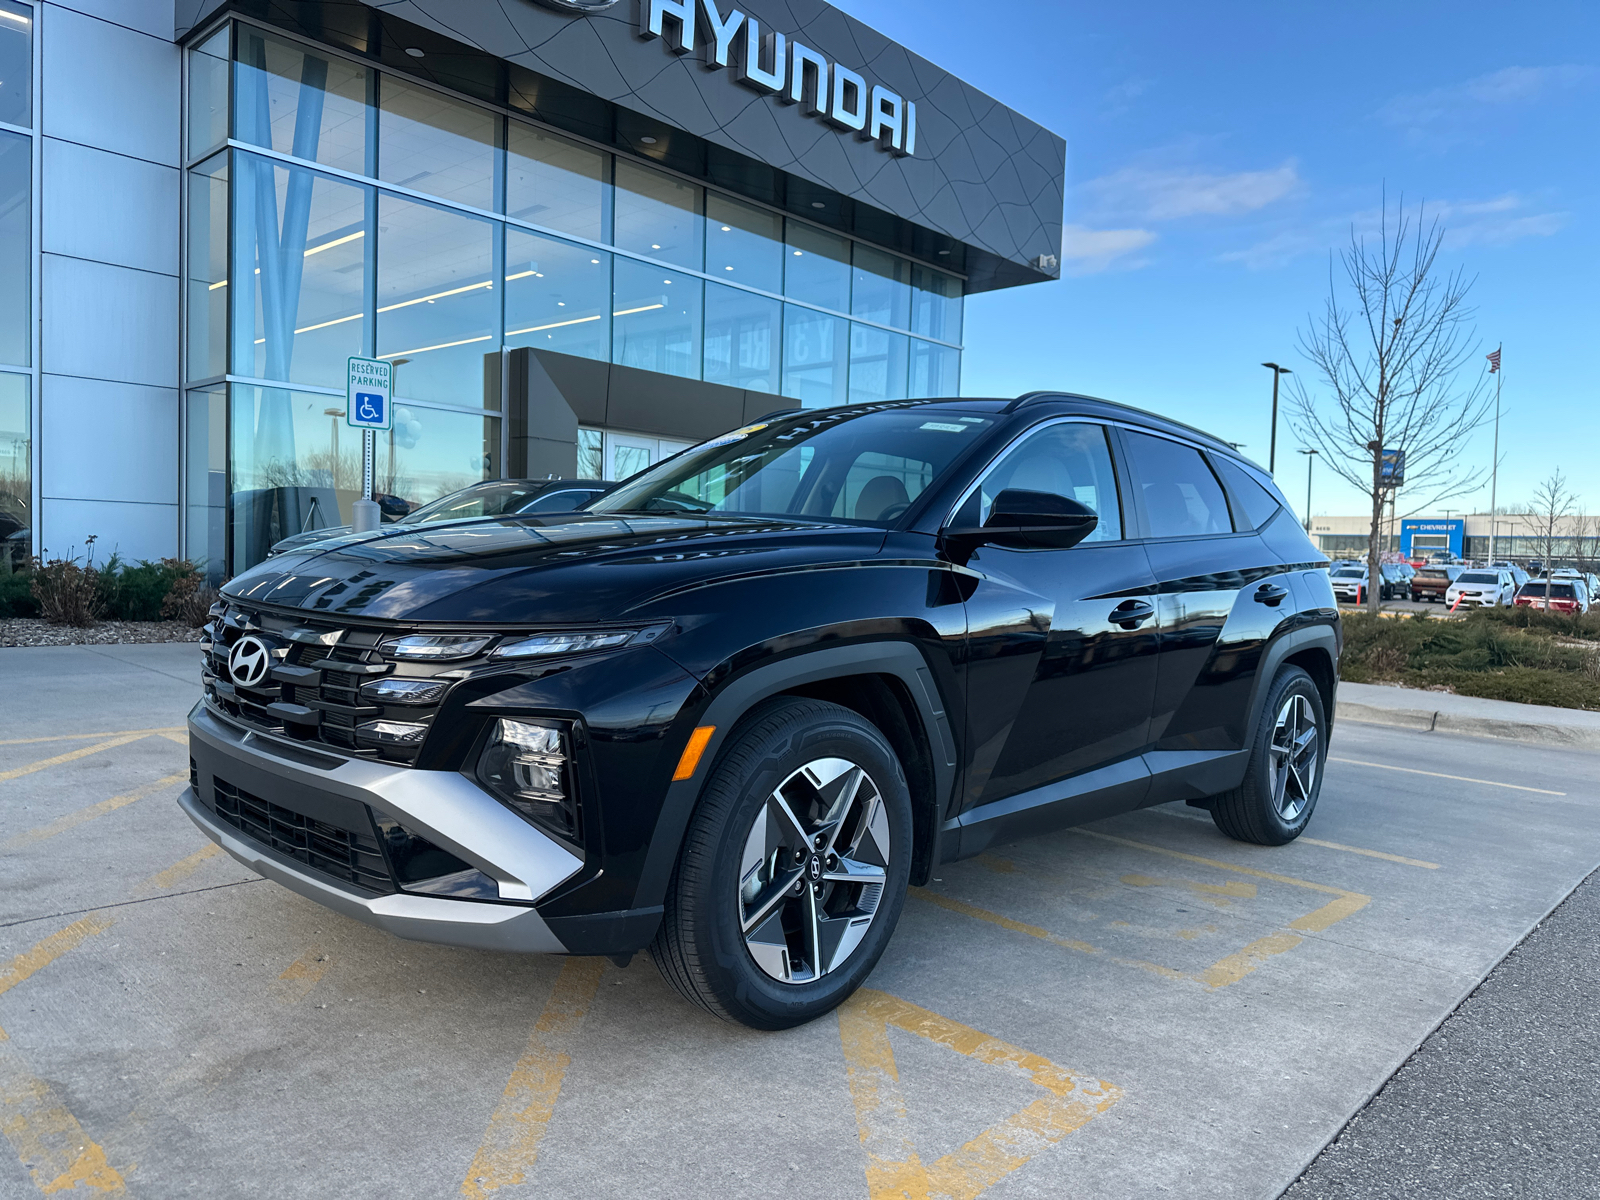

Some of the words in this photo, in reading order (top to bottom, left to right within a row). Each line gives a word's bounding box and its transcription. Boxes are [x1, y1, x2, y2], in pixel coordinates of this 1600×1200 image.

[648, 0, 917, 156] HYUNDAI
[351, 363, 388, 377] RESERVED
[351, 375, 388, 388] PARKING
